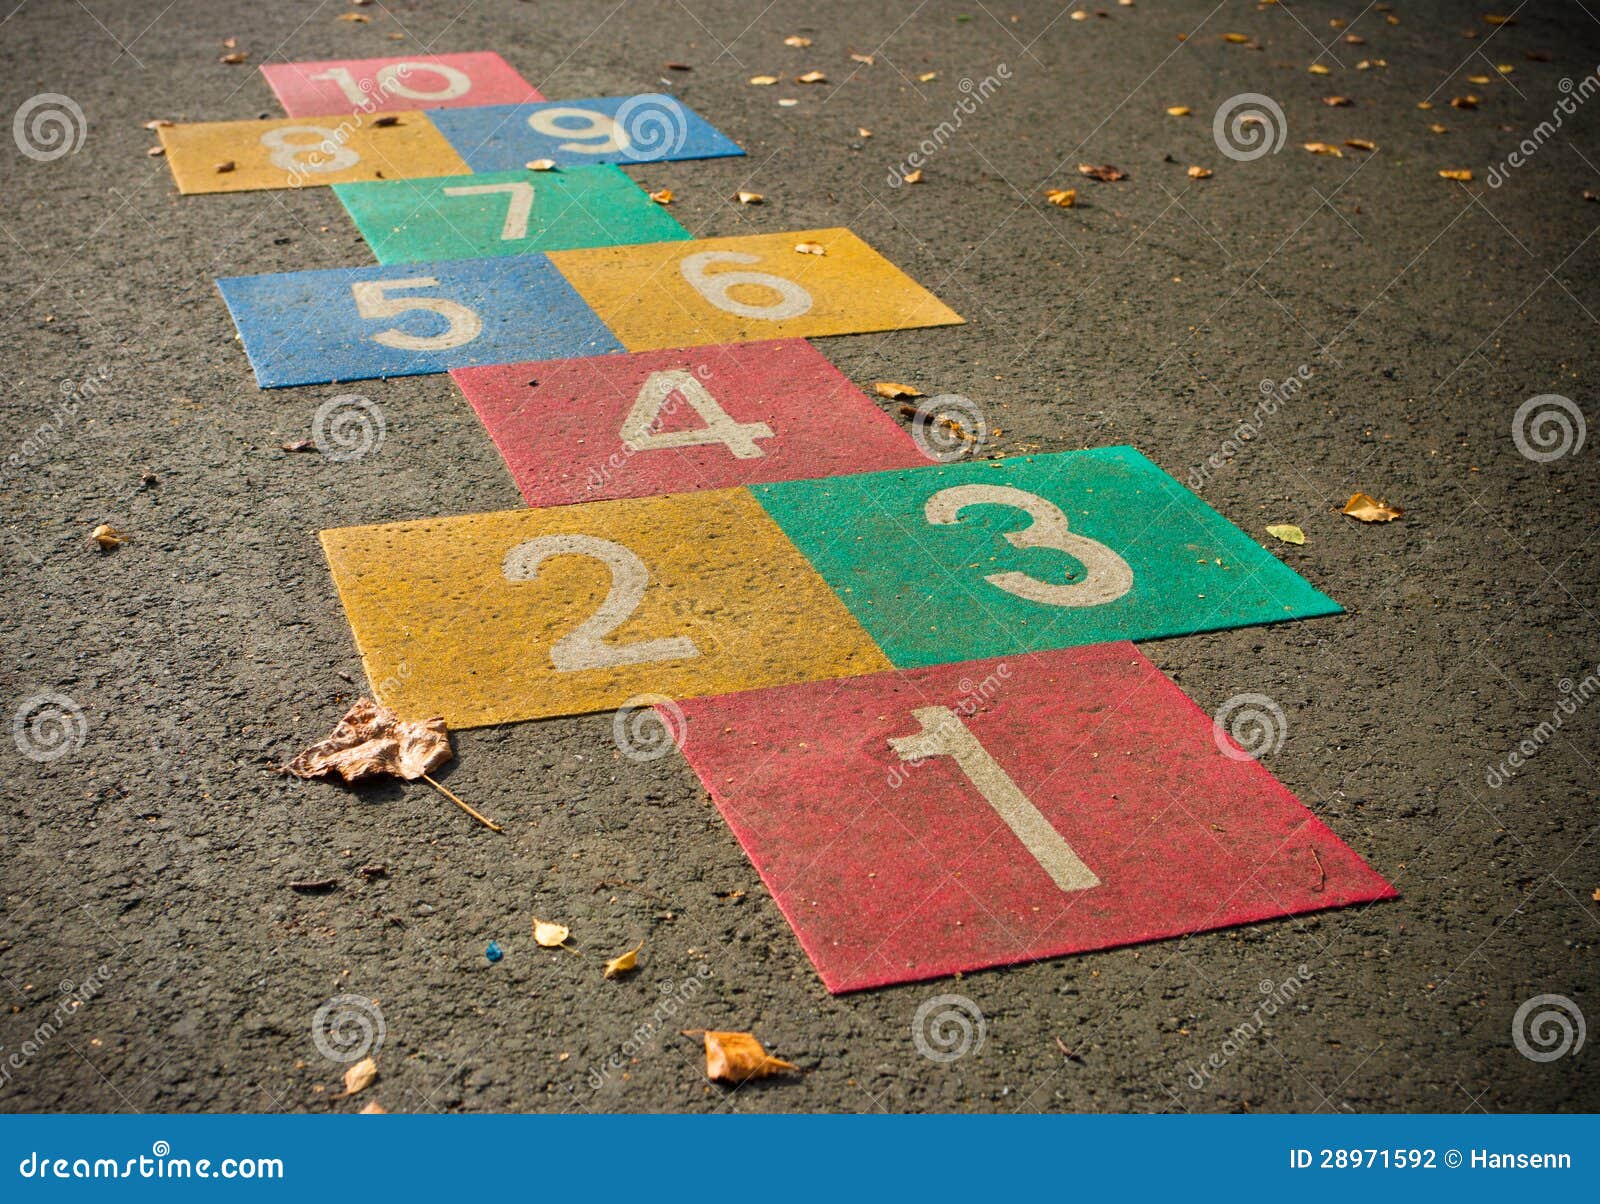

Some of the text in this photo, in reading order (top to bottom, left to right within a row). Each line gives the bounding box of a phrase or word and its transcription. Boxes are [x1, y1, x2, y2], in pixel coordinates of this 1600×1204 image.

[309, 62, 472, 107] 10
[259, 125, 361, 172] 8
[527, 107, 633, 154] 9
[442, 182, 536, 241] 7
[351, 277, 482, 351] 5
[680, 251, 814, 322] 6
[619, 368, 776, 460] 4
[924, 484, 1134, 608] 3
[502, 534, 700, 673] 2
[886, 705, 1101, 892] 1
